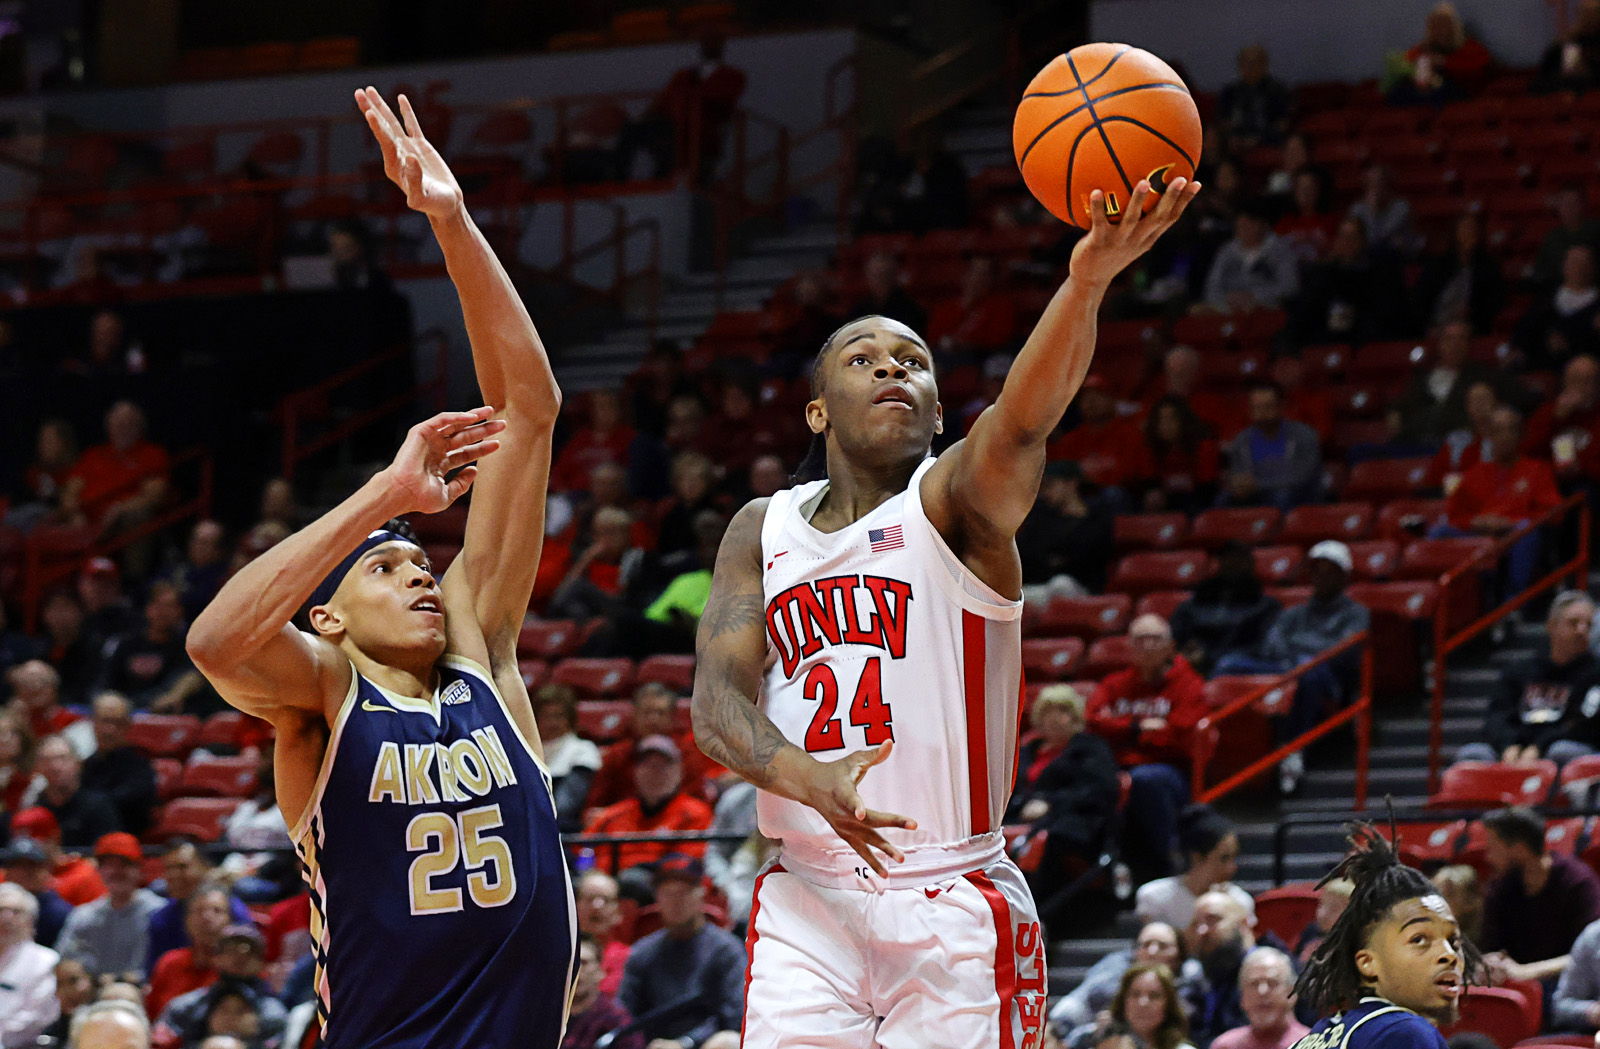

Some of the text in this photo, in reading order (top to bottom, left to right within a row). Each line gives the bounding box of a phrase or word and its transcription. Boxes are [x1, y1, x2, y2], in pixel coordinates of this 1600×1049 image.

[765, 573, 914, 680] UNLV
[802, 655, 895, 754] 24
[368, 724, 518, 806] AKRON
[405, 803, 517, 916] 25
